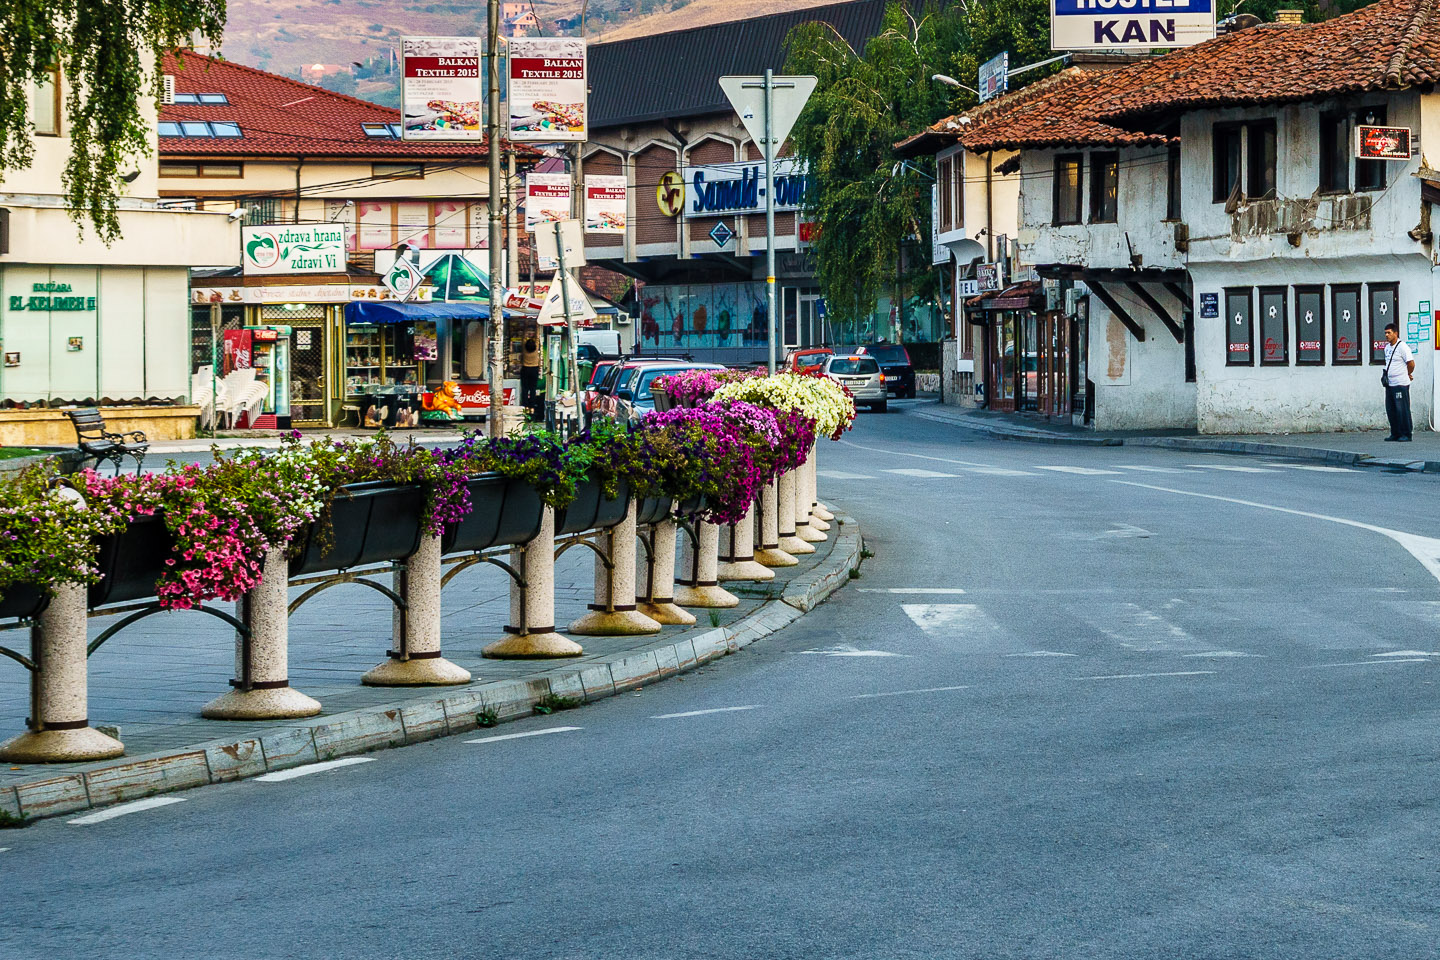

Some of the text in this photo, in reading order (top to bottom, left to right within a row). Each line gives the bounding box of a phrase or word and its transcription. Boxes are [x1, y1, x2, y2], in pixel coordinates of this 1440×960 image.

[1094, 19, 1175, 43] KAN
[438, 58, 477, 66] BALKAN
[544, 59, 582, 67] BALKAN
[415, 69, 478, 77] TEXTILE 2015
[521, 70, 583, 78] TEXTILE 2015
[278, 228, 342, 243] zdrava hrana
[291, 254, 337, 269] zdravi Vi
